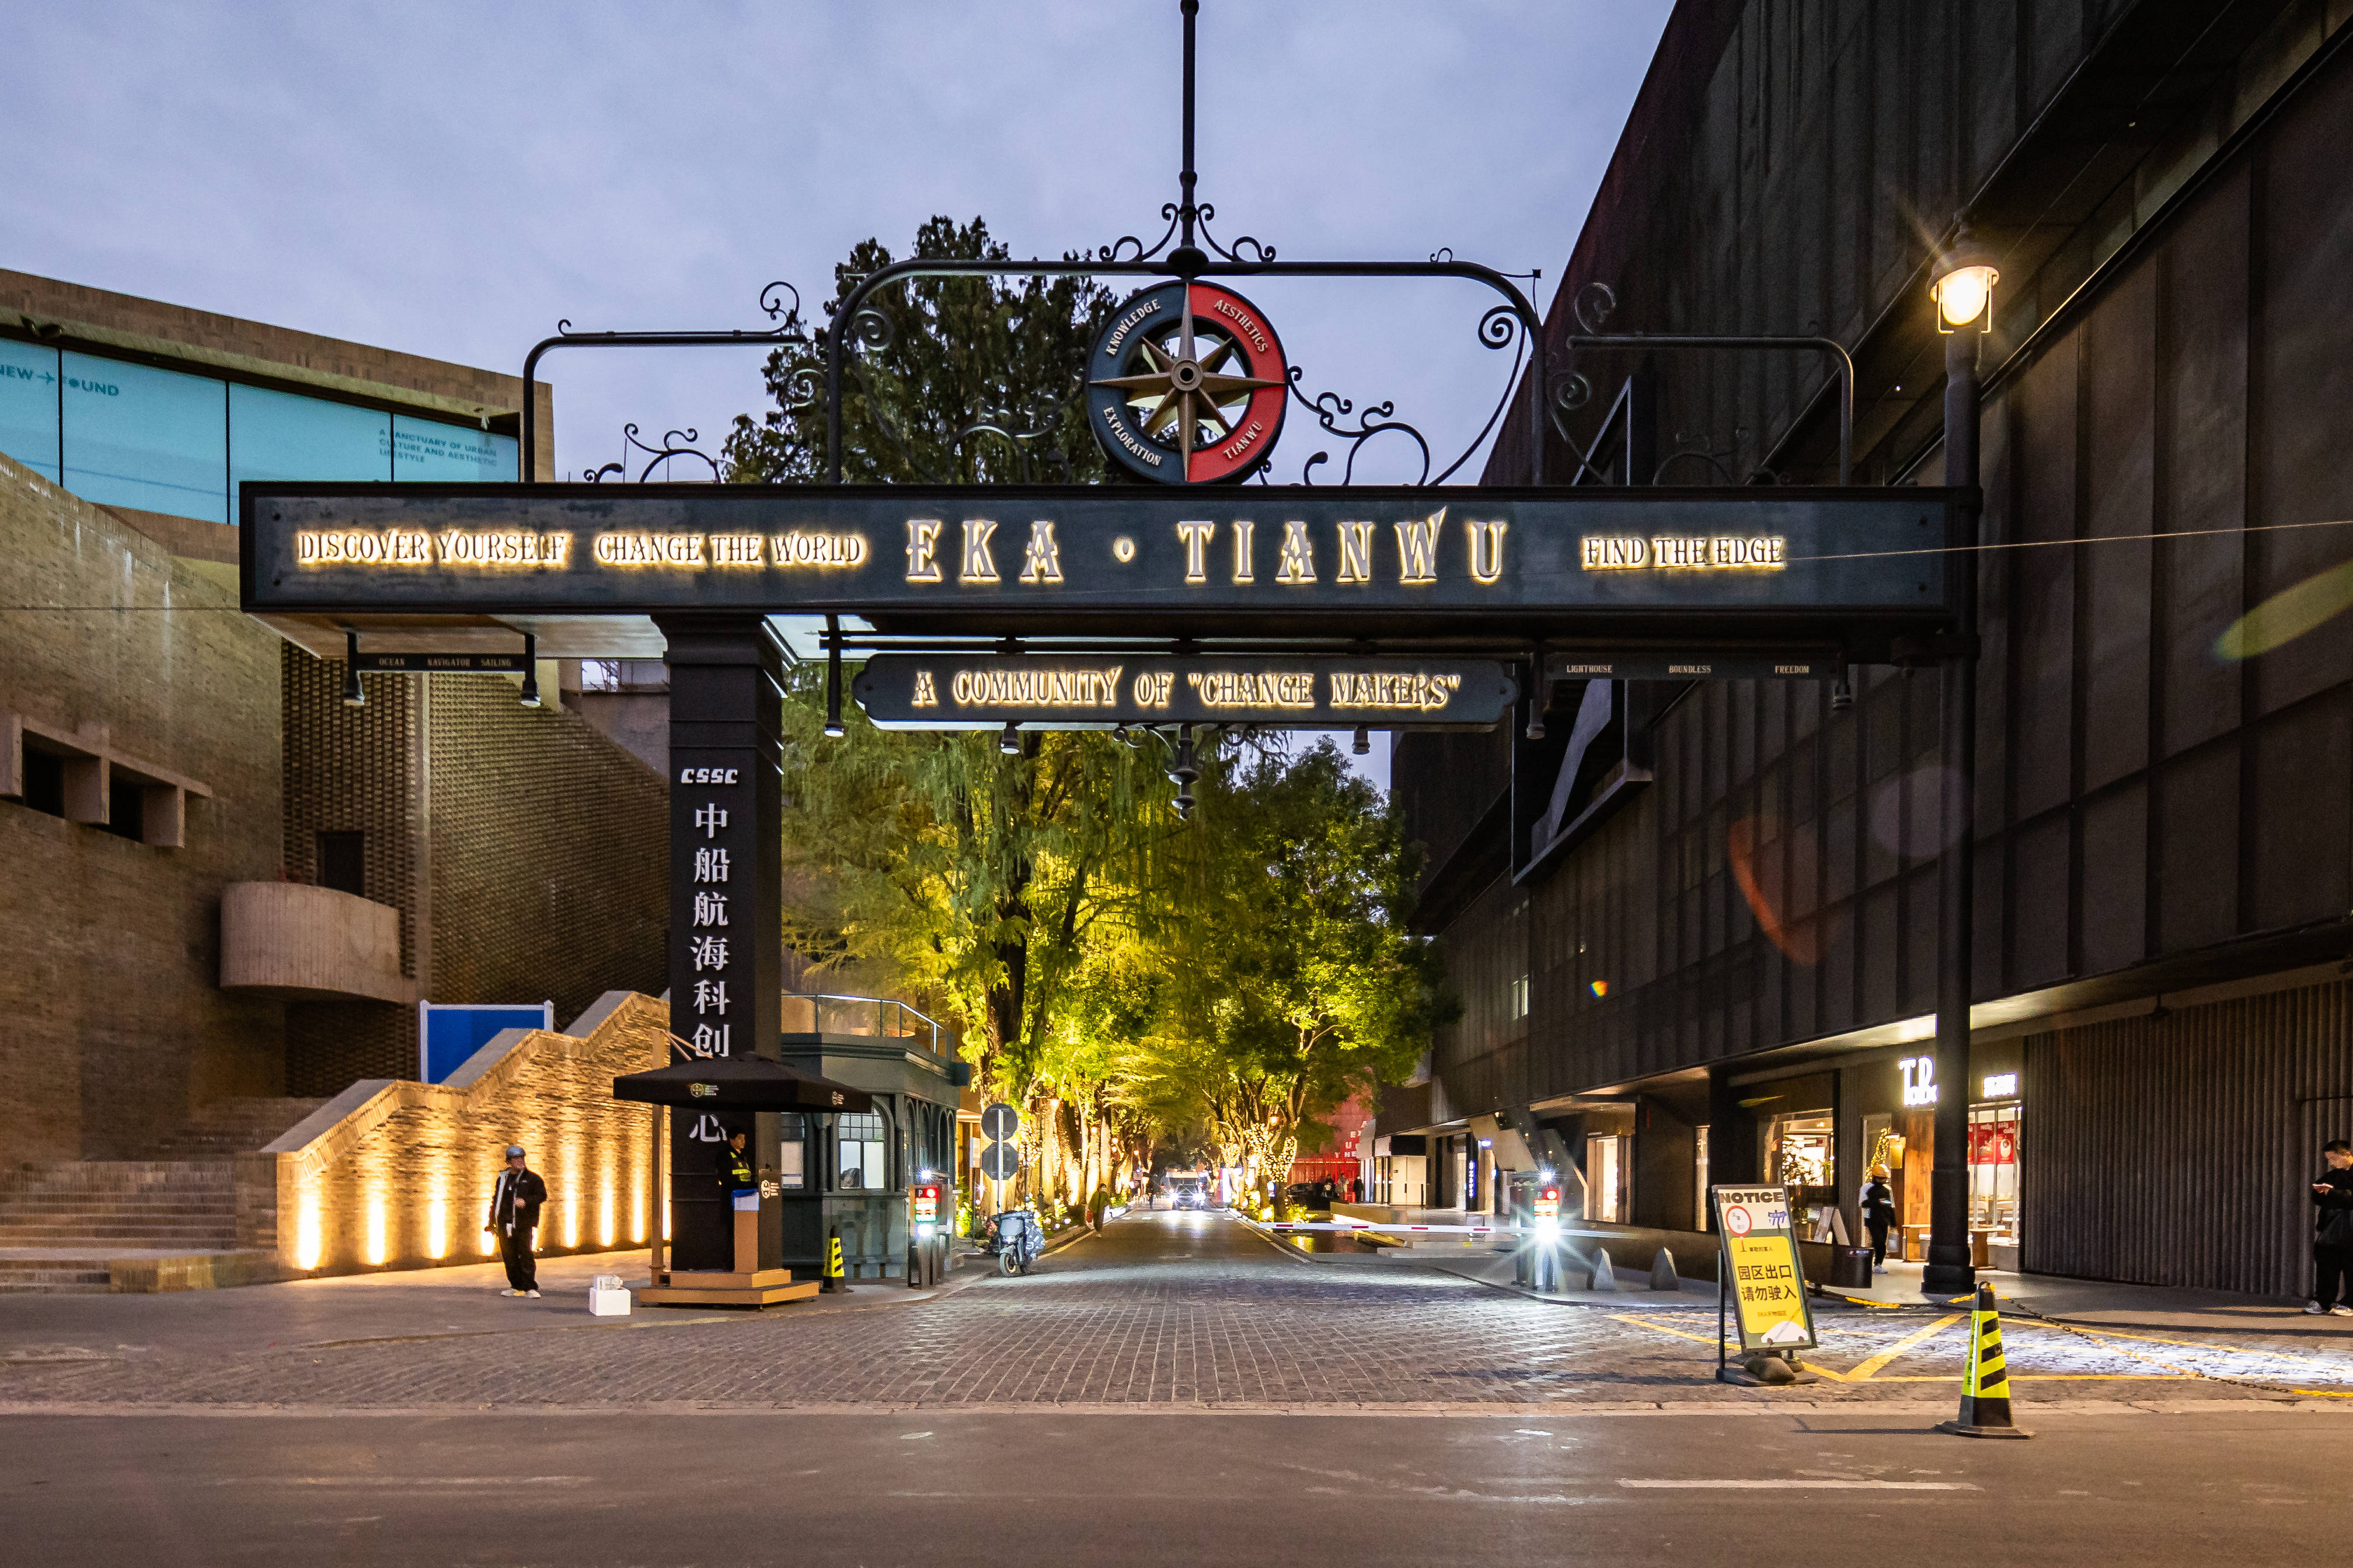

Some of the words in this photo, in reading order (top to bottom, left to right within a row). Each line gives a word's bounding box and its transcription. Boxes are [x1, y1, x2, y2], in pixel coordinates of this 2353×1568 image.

[1106, 299, 1161, 356] KNOWLEDGE
[1214, 299, 1268, 352] AESTHETICS
[395, 432, 447, 447] ANCTUARY
[1103, 407, 1162, 466] EXPLORATION
[1223, 420, 1263, 459] TIANWU
[300, 529, 426, 561] DISCOVER
[438, 529, 565, 561] YOURSELF
[598, 535, 702, 562] CHANGE
[711, 535, 761, 562] THE
[774, 530, 861, 562] WORLD
[906, 519, 1064, 582] EKA
[1177, 505, 1509, 583] TIANWU
[1585, 538, 1644, 564] FIND
[1654, 538, 1705, 564] THE
[1714, 538, 1783, 564] EDGE
[379, 658, 405, 667] OCEAN
[427, 658, 470, 668] NAVIGATOR
[481, 658, 511, 667] SAILING
[1567, 665, 1613, 673] LIGHTHOUSE
[1669, 665, 1711, 673] BOUNDLESS
[1775, 665, 1810, 673] FREEDOM
[912, 671, 938, 706] A
[953, 666, 1123, 706] COMMUNITY
[1135, 672, 1174, 706] OF
[689, 802, 731, 1142] 中船航海科创心
[1718, 1192, 1785, 1203] NOTICE
[1738, 1265, 1792, 1280] 园区出口
[1741, 1285, 1797, 1301] 请勿驶入
